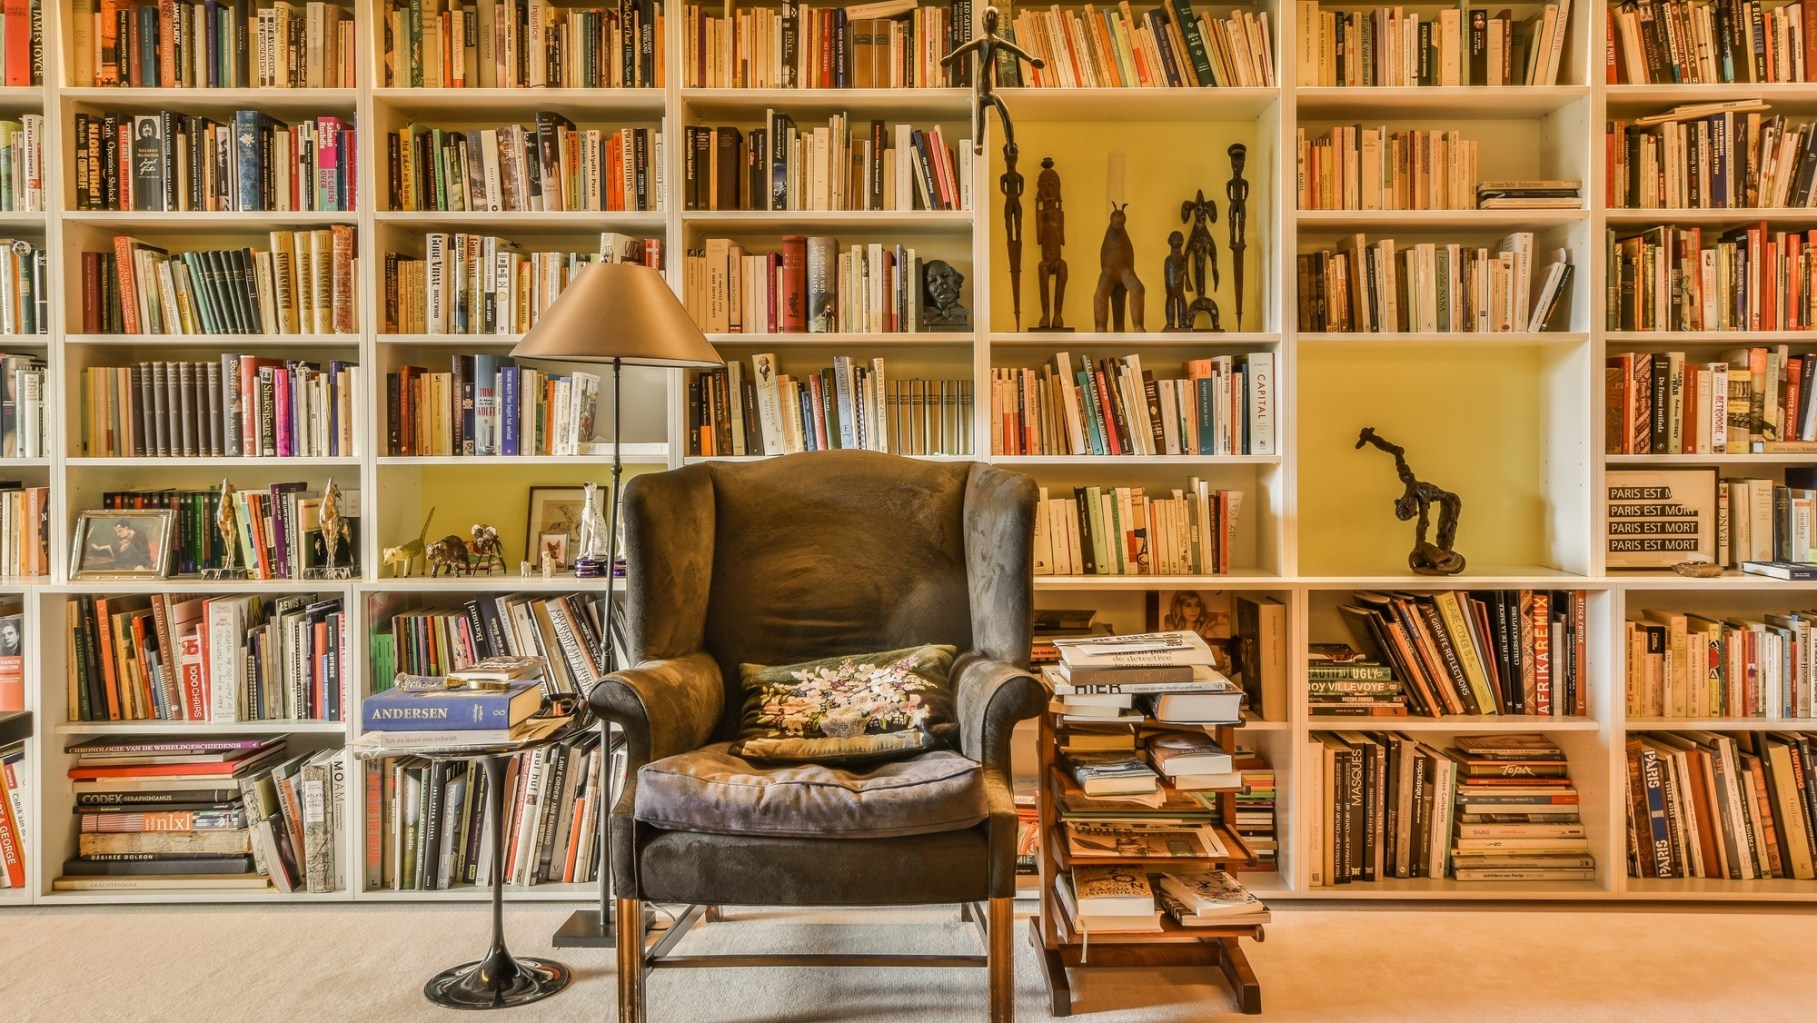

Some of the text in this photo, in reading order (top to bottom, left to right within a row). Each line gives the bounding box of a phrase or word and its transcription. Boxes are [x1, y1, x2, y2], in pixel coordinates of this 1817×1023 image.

[412, 12, 420, 32] Smith
[531, 5, 539, 40] Injustice
[1752, 8, 1761, 25] BEAT
[33, 10, 43, 76] JAMES JOYCE
[78, 159, 88, 189] COUNTERLIFE
[88, 123, 100, 196] PHILIP ROTH
[104, 117, 117, 202] Roth Operation Shylock
[328, 170, 334, 179] DE
[431, 235, 442, 260] GORE
[276, 253, 291, 309] SHAKESPEARE
[317, 252, 330, 309] SHAKESPEARE
[432, 261, 442, 286] VIDAL
[480, 388, 493, 397] TOM
[838, 366, 846, 395] FLAUBERT
[1658, 377, 1664, 385] De
[263, 385, 273, 436] Shakespeare
[1257, 374, 1266, 419] CAPITAL
[1714, 395, 1724, 434] METRONOME
[1611, 488, 1663, 498] PARIS EST
[1611, 506, 1663, 515] PARIS EST
[1611, 522, 1695, 533] PARIS EST MORT
[1720, 505, 1728, 548] FRANCE
[1611, 539, 1695, 550] PARIS EST MORT
[468, 605, 483, 642] Bonnard
[154, 602, 174, 691] KATHMANDU VALLEY STYLE
[1430, 618, 1470, 696] GIRAFFE REFLECTIONS
[1534, 596, 1550, 714] AFRIKA REMIX
[1328, 683, 1384, 691] VILLEVOYE
[1353, 668, 1378, 679] UGLY
[189, 665, 202, 718] 1000 CHAIRS
[372, 708, 448, 719] ANDERSEN
[153, 743, 242, 751] WERELDGESCHIEDENIS
[333, 761, 345, 803] MOAM
[529, 773, 540, 791] huf
[1351, 749, 1363, 806] MASQUES
[1414, 759, 1424, 799] l'abstraction
[1644, 750, 1659, 788] PARIS
[1792, 749, 1804, 789] namibia
[82, 794, 123, 805] CODEX
[552, 777, 561, 800] ORDER
[157, 813, 191, 831] nlxl
[550, 802, 558, 814] JAN
[544, 815, 555, 845] BANNING
[0, 826, 16, 865] GEORGE
[1655, 839, 1672, 878] PARIS
